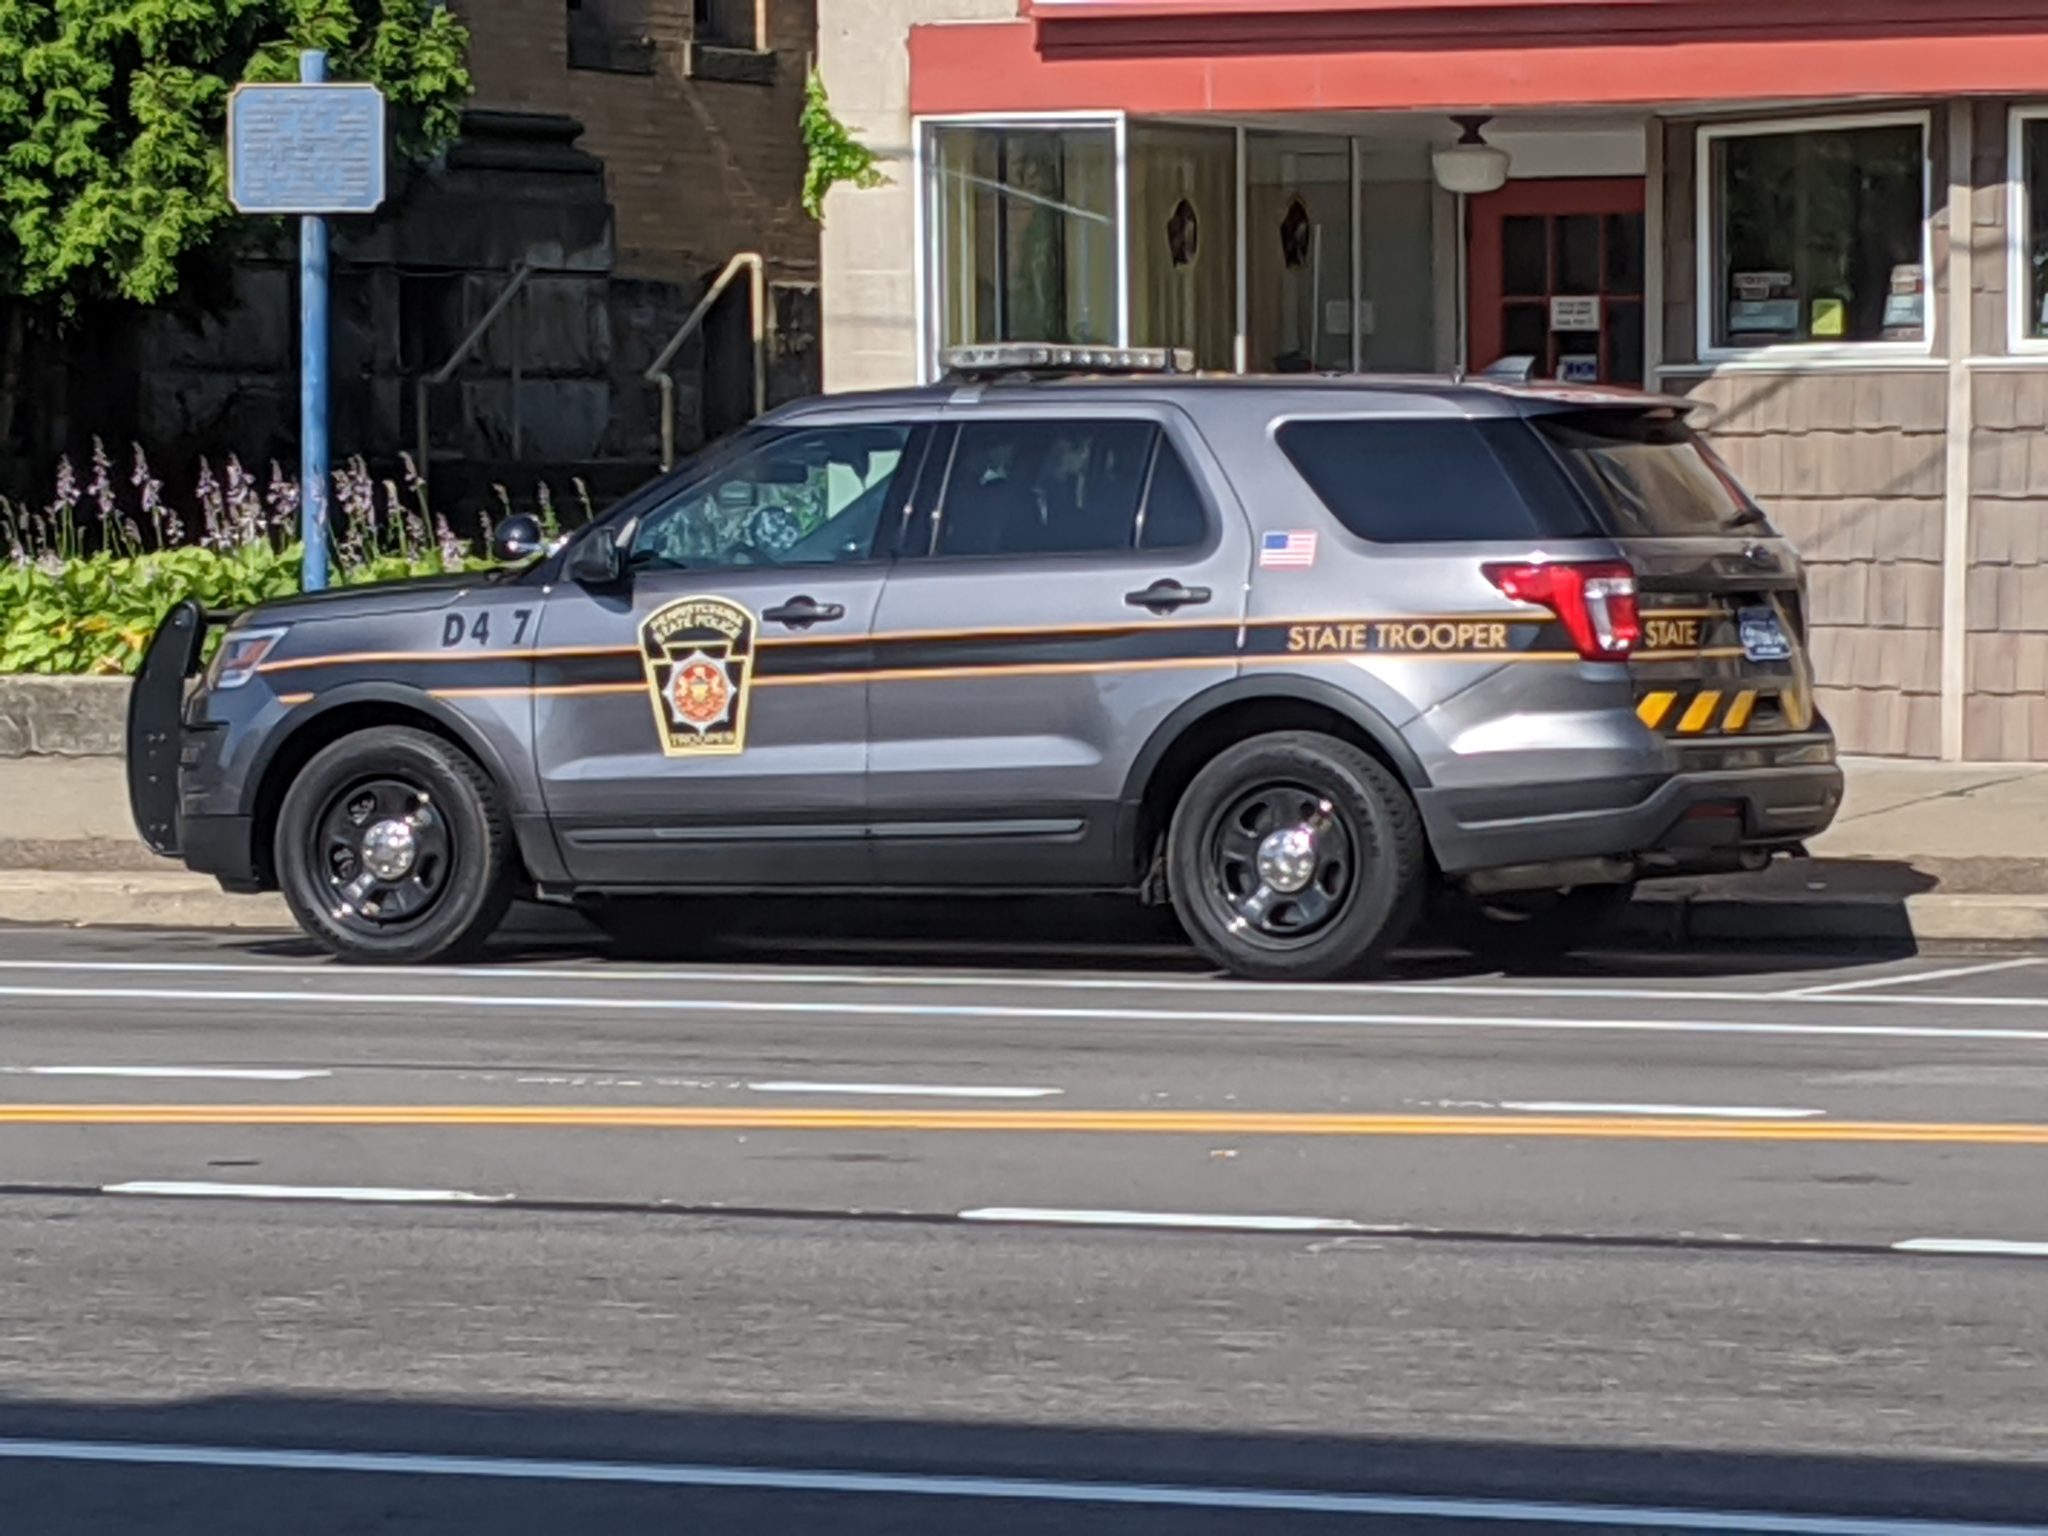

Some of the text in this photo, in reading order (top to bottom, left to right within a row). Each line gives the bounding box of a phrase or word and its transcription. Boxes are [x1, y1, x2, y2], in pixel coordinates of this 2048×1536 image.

[1288, 622, 1507, 650] STATE TROOPER
[1644, 620, 1698, 648] STATE
